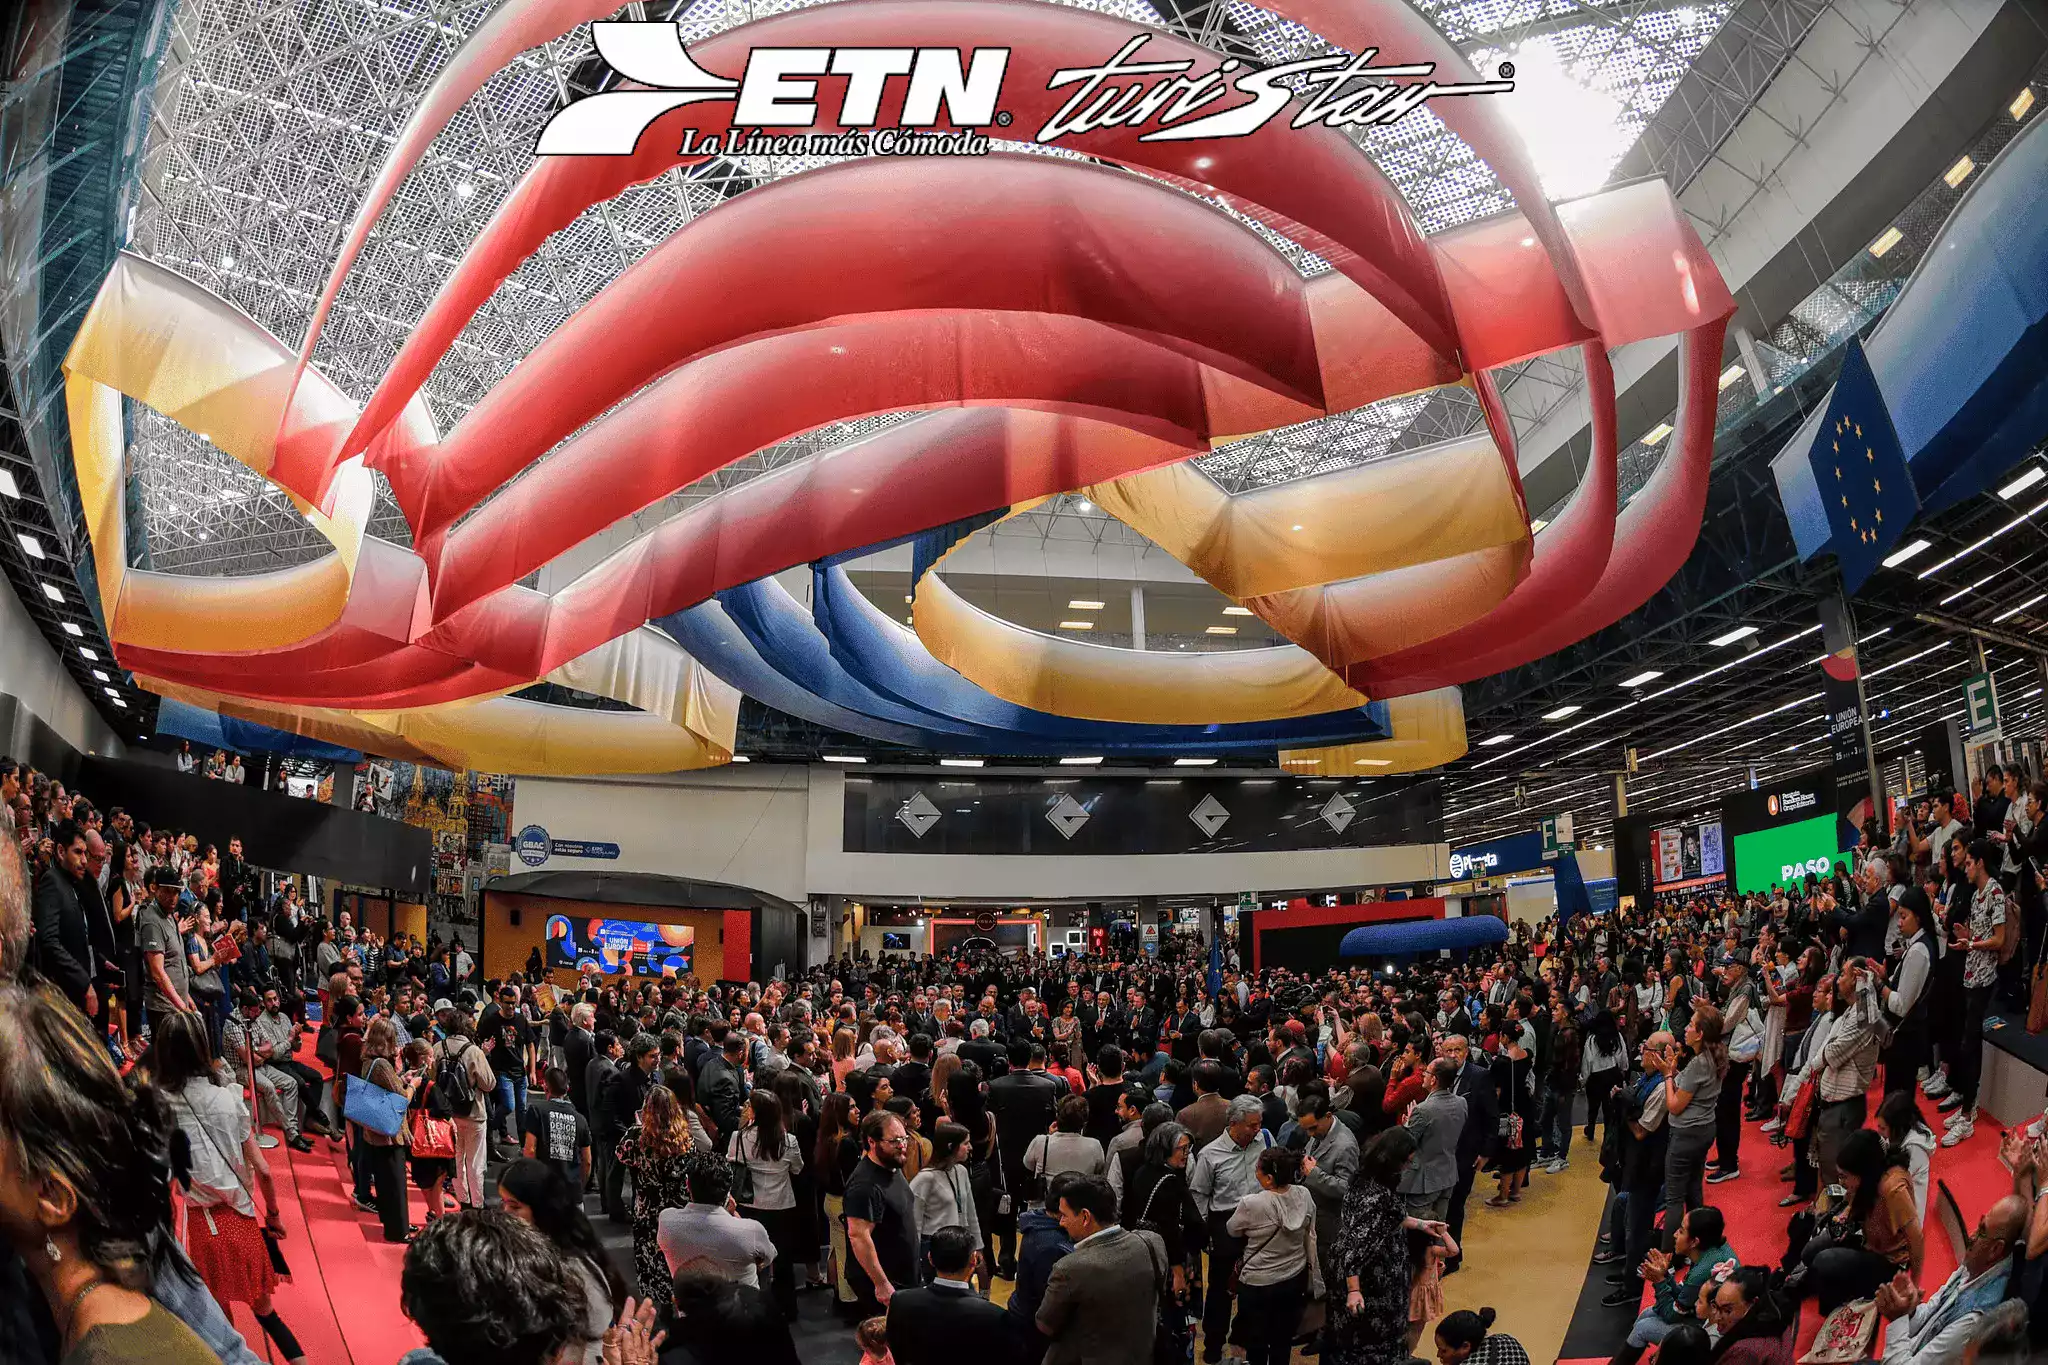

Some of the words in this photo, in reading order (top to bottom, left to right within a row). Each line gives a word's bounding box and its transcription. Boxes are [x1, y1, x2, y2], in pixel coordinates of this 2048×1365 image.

[1967, 679, 1992, 729] E
[1835, 706, 1857, 723] UNIÓN
[1831, 715, 1864, 734] EUROPEA
[1542, 819, 1553, 849] F
[522, 841, 545, 849] GBAC
[1781, 856, 1830, 882] PASO
[604, 942, 633, 951] EUROPEA
[609, 936, 629, 944] UNIÓN
[549, 1111, 575, 1122] STAND
